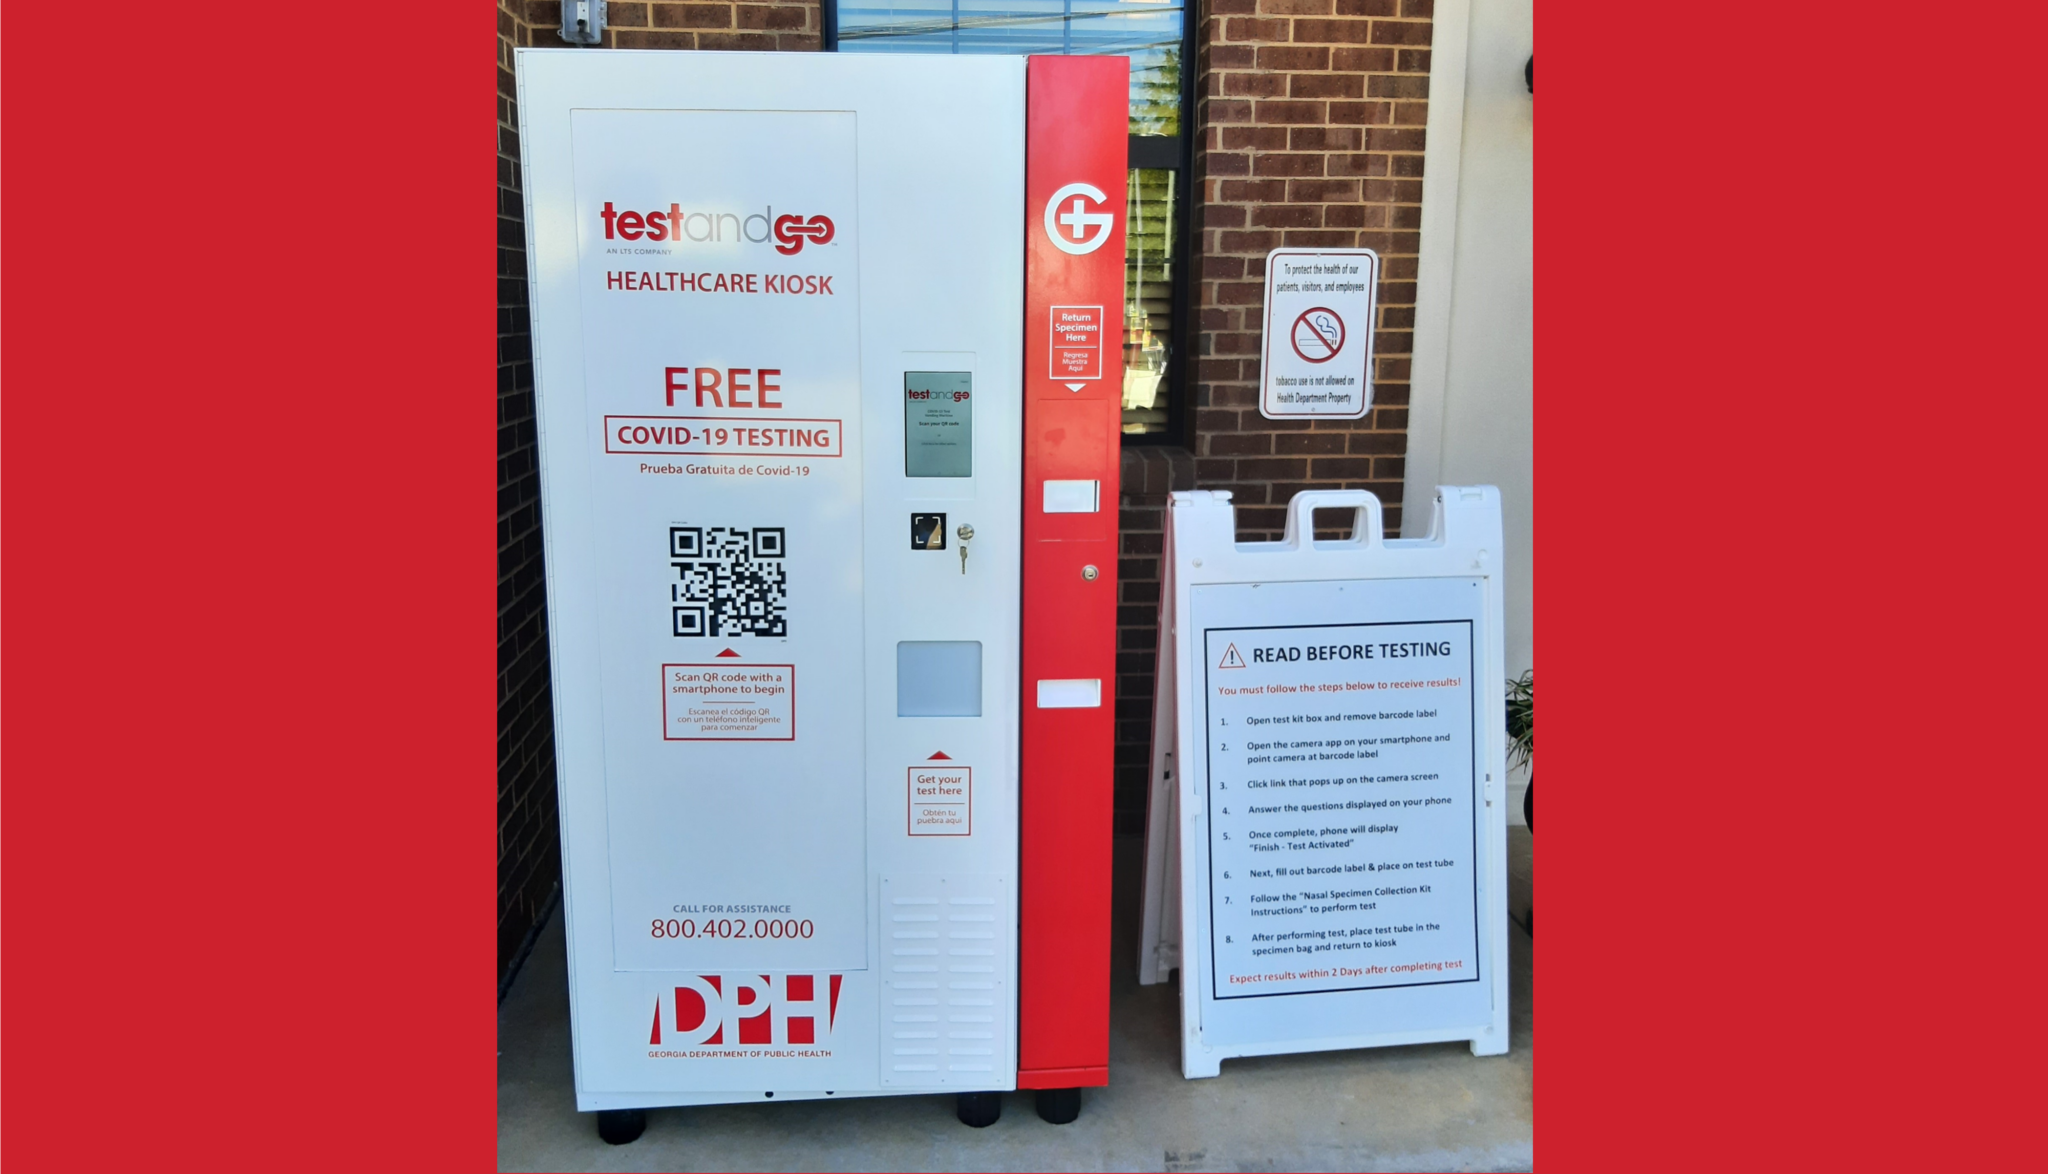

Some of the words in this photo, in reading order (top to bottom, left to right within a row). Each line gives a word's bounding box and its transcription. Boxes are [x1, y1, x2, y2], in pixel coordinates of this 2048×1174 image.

[600, 202, 835, 256] testandgo
[1292, 265, 1312, 276] protect
[1313, 264, 1322, 274] the
[1323, 263, 1341, 274] health
[1349, 266, 1359, 274] our
[607, 271, 758, 293] HEALTHCARE
[765, 274, 833, 295] KIOSK
[1276, 281, 1300, 294] patients,
[1301, 281, 1323, 293] visitors,
[1324, 281, 1335, 292] and
[1335, 281, 1365, 294] employees
[1062, 313, 1091, 321] Return
[1055, 323, 1098, 333] Specimen
[1066, 333, 1087, 342] Here
[1063, 351, 1088, 359] Regresa
[1276, 376, 1297, 386] tobacco
[1298, 378, 1308, 386] use
[1315, 376, 1325, 386] not
[1325, 375, 1347, 386] allowed
[665, 367, 782, 409] FREE
[908, 389, 970, 403] testandgo
[1277, 392, 1294, 403] Health
[1295, 392, 1327, 405] Department
[1328, 392, 1351, 405] Property
[618, 426, 728, 446] COVID-19
[733, 428, 829, 447] TESTING
[640, 463, 683, 474] Prueba
[686, 463, 735, 475] Gratuita
[738, 464, 753, 475] de
[756, 465, 810, 476] Covid-19
[1253, 647, 1301, 663] READ
[1307, 644, 1374, 661] BEFORE
[1378, 641, 1450, 658] TESTING
[675, 672, 700, 682] Scan
[703, 672, 719, 683] QR
[721, 672, 747, 682] code
[749, 673, 773, 682] with
[672, 684, 738, 695] smartphone
[740, 685, 752, 694] to
[754, 684, 785, 696] begin
[1218, 687, 1237, 695] You
[1239, 686, 1264, 694] must
[1266, 684, 1297, 694] follow
[1299, 683, 1316, 693] the
[1318, 684, 1343, 693] steps
[1346, 681, 1375, 691] below
[1390, 679, 1424, 689] receive
[1427, 677, 1461, 687] results!
[688, 708, 720, 716] Escanea
[758, 708, 770, 716] QR
[1246, 716, 1271, 726] Open
[1273, 716, 1290, 724] test
[1292, 715, 1304, 723] kit
[1306, 714, 1322, 723] box
[1324, 713, 1341, 722] and
[1343, 713, 1377, 721] remove
[1379, 710, 1414, 720] barcode
[1416, 709, 1437, 718] label
[739, 716, 781, 724] inteligente
[1247, 741, 1271, 752] Open
[1273, 740, 1288, 749] the
[1290, 740, 1323, 748] camera
[1325, 740, 1342, 748] app
[1357, 738, 1378, 747] your
[1380, 735, 1432, 745] smartphone
[1434, 733, 1450, 742] and
[1247, 755, 1271, 765] point
[1273, 754, 1306, 762] camera
[1319, 751, 1355, 760] barcode
[1357, 749, 1378, 759] label
[917, 774, 936, 784] Get
[938, 777, 962, 786] your
[1247, 780, 1268, 789] Click
[1270, 779, 1286, 787] link
[1288, 778, 1307, 787] that
[1309, 779, 1330, 788] pops
[1332, 778, 1344, 786] up
[1359, 775, 1374, 783] the
[1376, 775, 1409, 783] camera
[1410, 773, 1439, 781] screen
[917, 787, 936, 795] test
[939, 786, 962, 795] here
[1248, 806, 1282, 814] Answer
[1284, 804, 1299, 812] the
[1301, 802, 1344, 813] questions
[1345, 799, 1387, 810] displayed
[1402, 799, 1423, 808] your
[1425, 796, 1452, 807] phone
[917, 817, 944, 825] puebra
[1248, 831, 1272, 839] Once
[1273, 828, 1318, 839] complete,
[1320, 827, 1348, 837] phone
[1350, 825, 1366, 834] will
[1367, 824, 1399, 834] display
[1287, 842, 1306, 850] Test
[1250, 869, 1273, 878] Next,
[1275, 867, 1287, 876] fill
[1289, 868, 1304, 876] out
[1306, 865, 1342, 875] barcode
[1344, 863, 1366, 873] label
[1377, 862, 1400, 873] place
[1402, 862, 1414, 870] on
[1415, 860, 1432, 869] test
[1434, 859, 1454, 867] tube
[1250, 894, 1280, 903] Follow
[1282, 893, 1297, 901] the
[1330, 889, 1373, 900] Specimen
[1374, 886, 1418, 896] Collection
[1419, 885, 1431, 893] Kit
[673, 904, 700, 913] CALL
[702, 904, 724, 913] FOR
[726, 905, 791, 913] ASSISTANCE
[1321, 903, 1357, 914] perform
[1359, 902, 1376, 910] test
[651, 919, 814, 939] 800.402.0000
[1252, 933, 1274, 942] After
[1276, 930, 1326, 942] performing
[1328, 929, 1348, 938] test,
[1350, 927, 1373, 938] place
[1375, 926, 1392, 935] test
[1393, 924, 1414, 933] tube
[1426, 922, 1440, 931] the
[1252, 946, 1294, 957] specimen
[1296, 944, 1313, 954] bag
[1314, 942, 1331, 952] and
[1333, 942, 1361, 950] return
[1374, 938, 1397, 947] kiosk
[1230, 974, 1262, 985] Expect
[1264, 971, 1296, 981] results
[1298, 969, 1329, 979] within
[1340, 967, 1363, 977] Days
[1365, 965, 1388, 975] after
[1390, 961, 1443, 973] completing
[1445, 960, 1462, 969] test
[650, 974, 843, 1045] DPH
[689, 1050, 748, 1058] DEPARTMENT
[764, 1050, 795, 1058] PUBLIC
